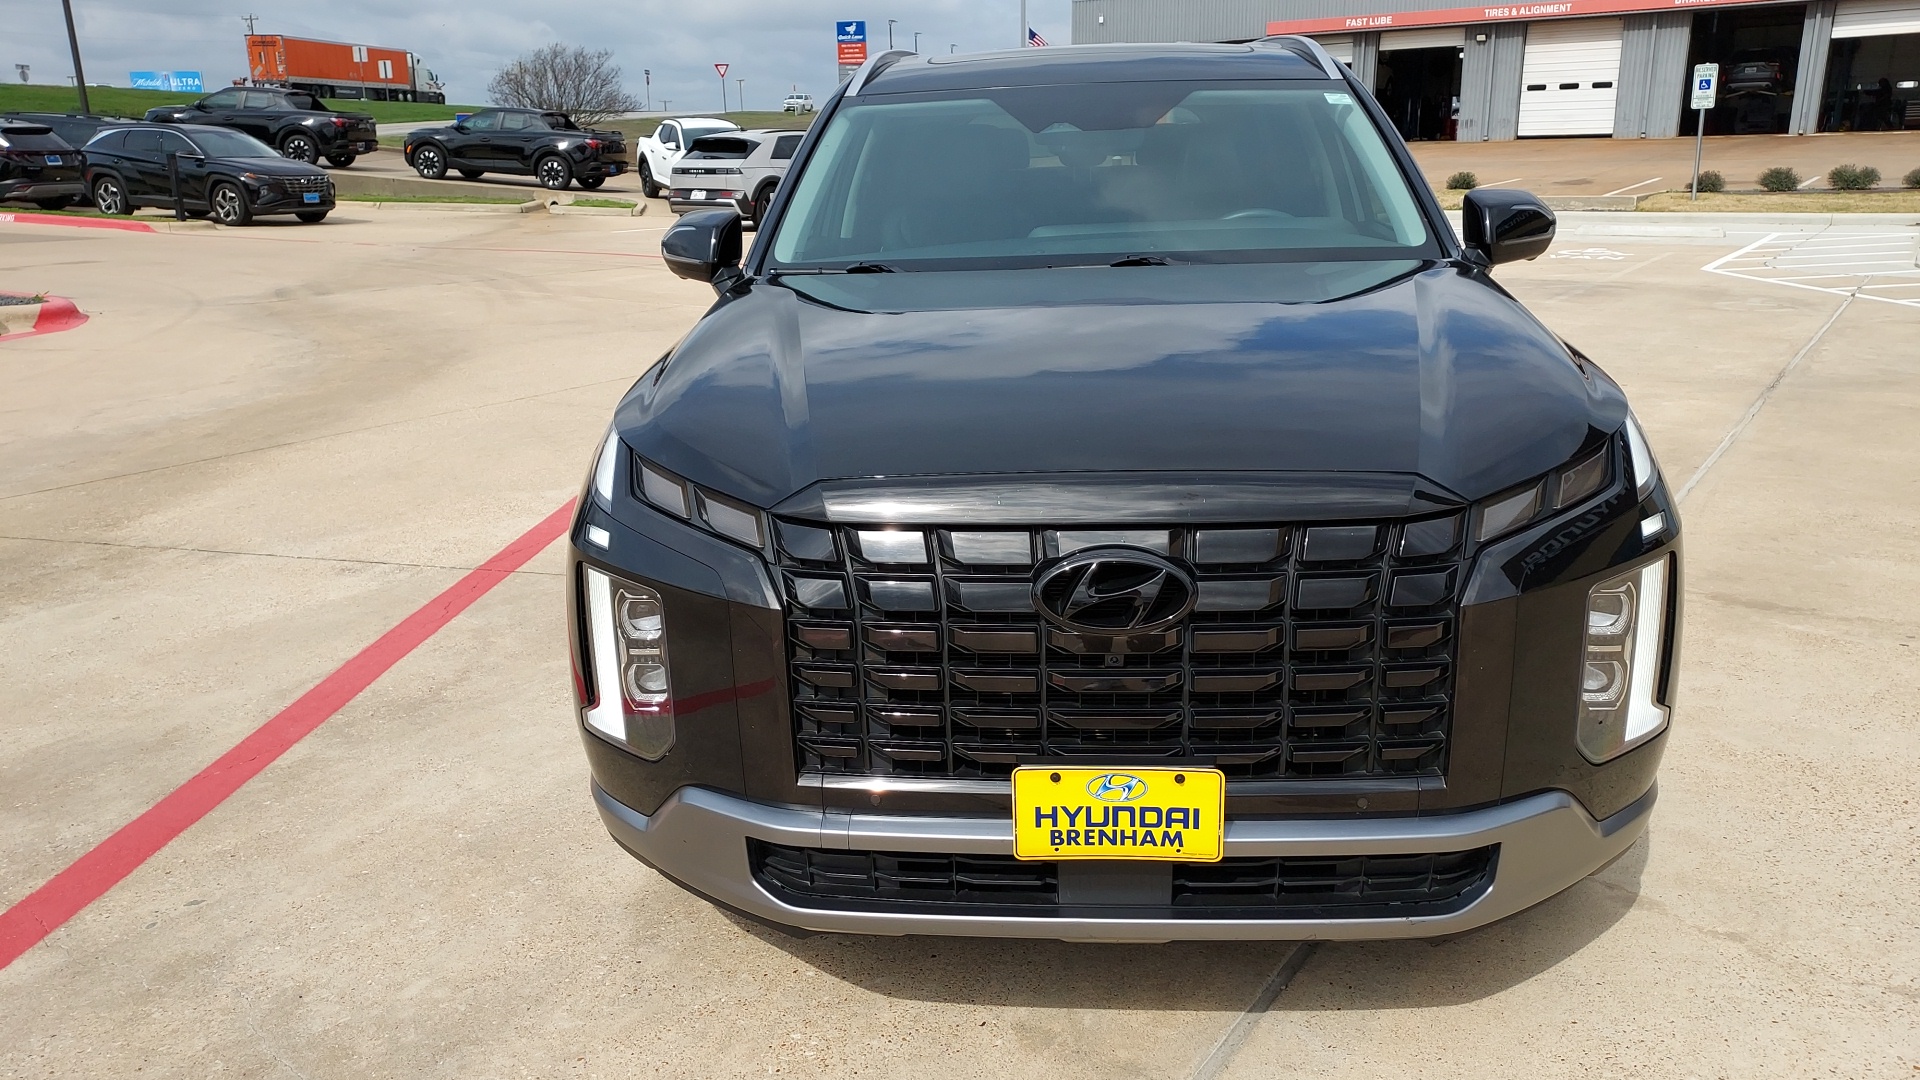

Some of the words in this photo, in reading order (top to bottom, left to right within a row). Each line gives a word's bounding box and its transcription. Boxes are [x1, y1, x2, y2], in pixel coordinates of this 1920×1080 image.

[1484, 8, 1509, 17] TIRES
[1511, 7, 1517, 16] &
[1520, 3, 1572, 15] ALIGNMENT
[1345, 17, 1368, 27] FAST
[1369, 16, 1393, 25] LUBE
[170, 77, 200, 86] ULTRA
[1035, 806, 1200, 829] HYUNDAI
[1050, 829, 1184, 847] BRENHAM
